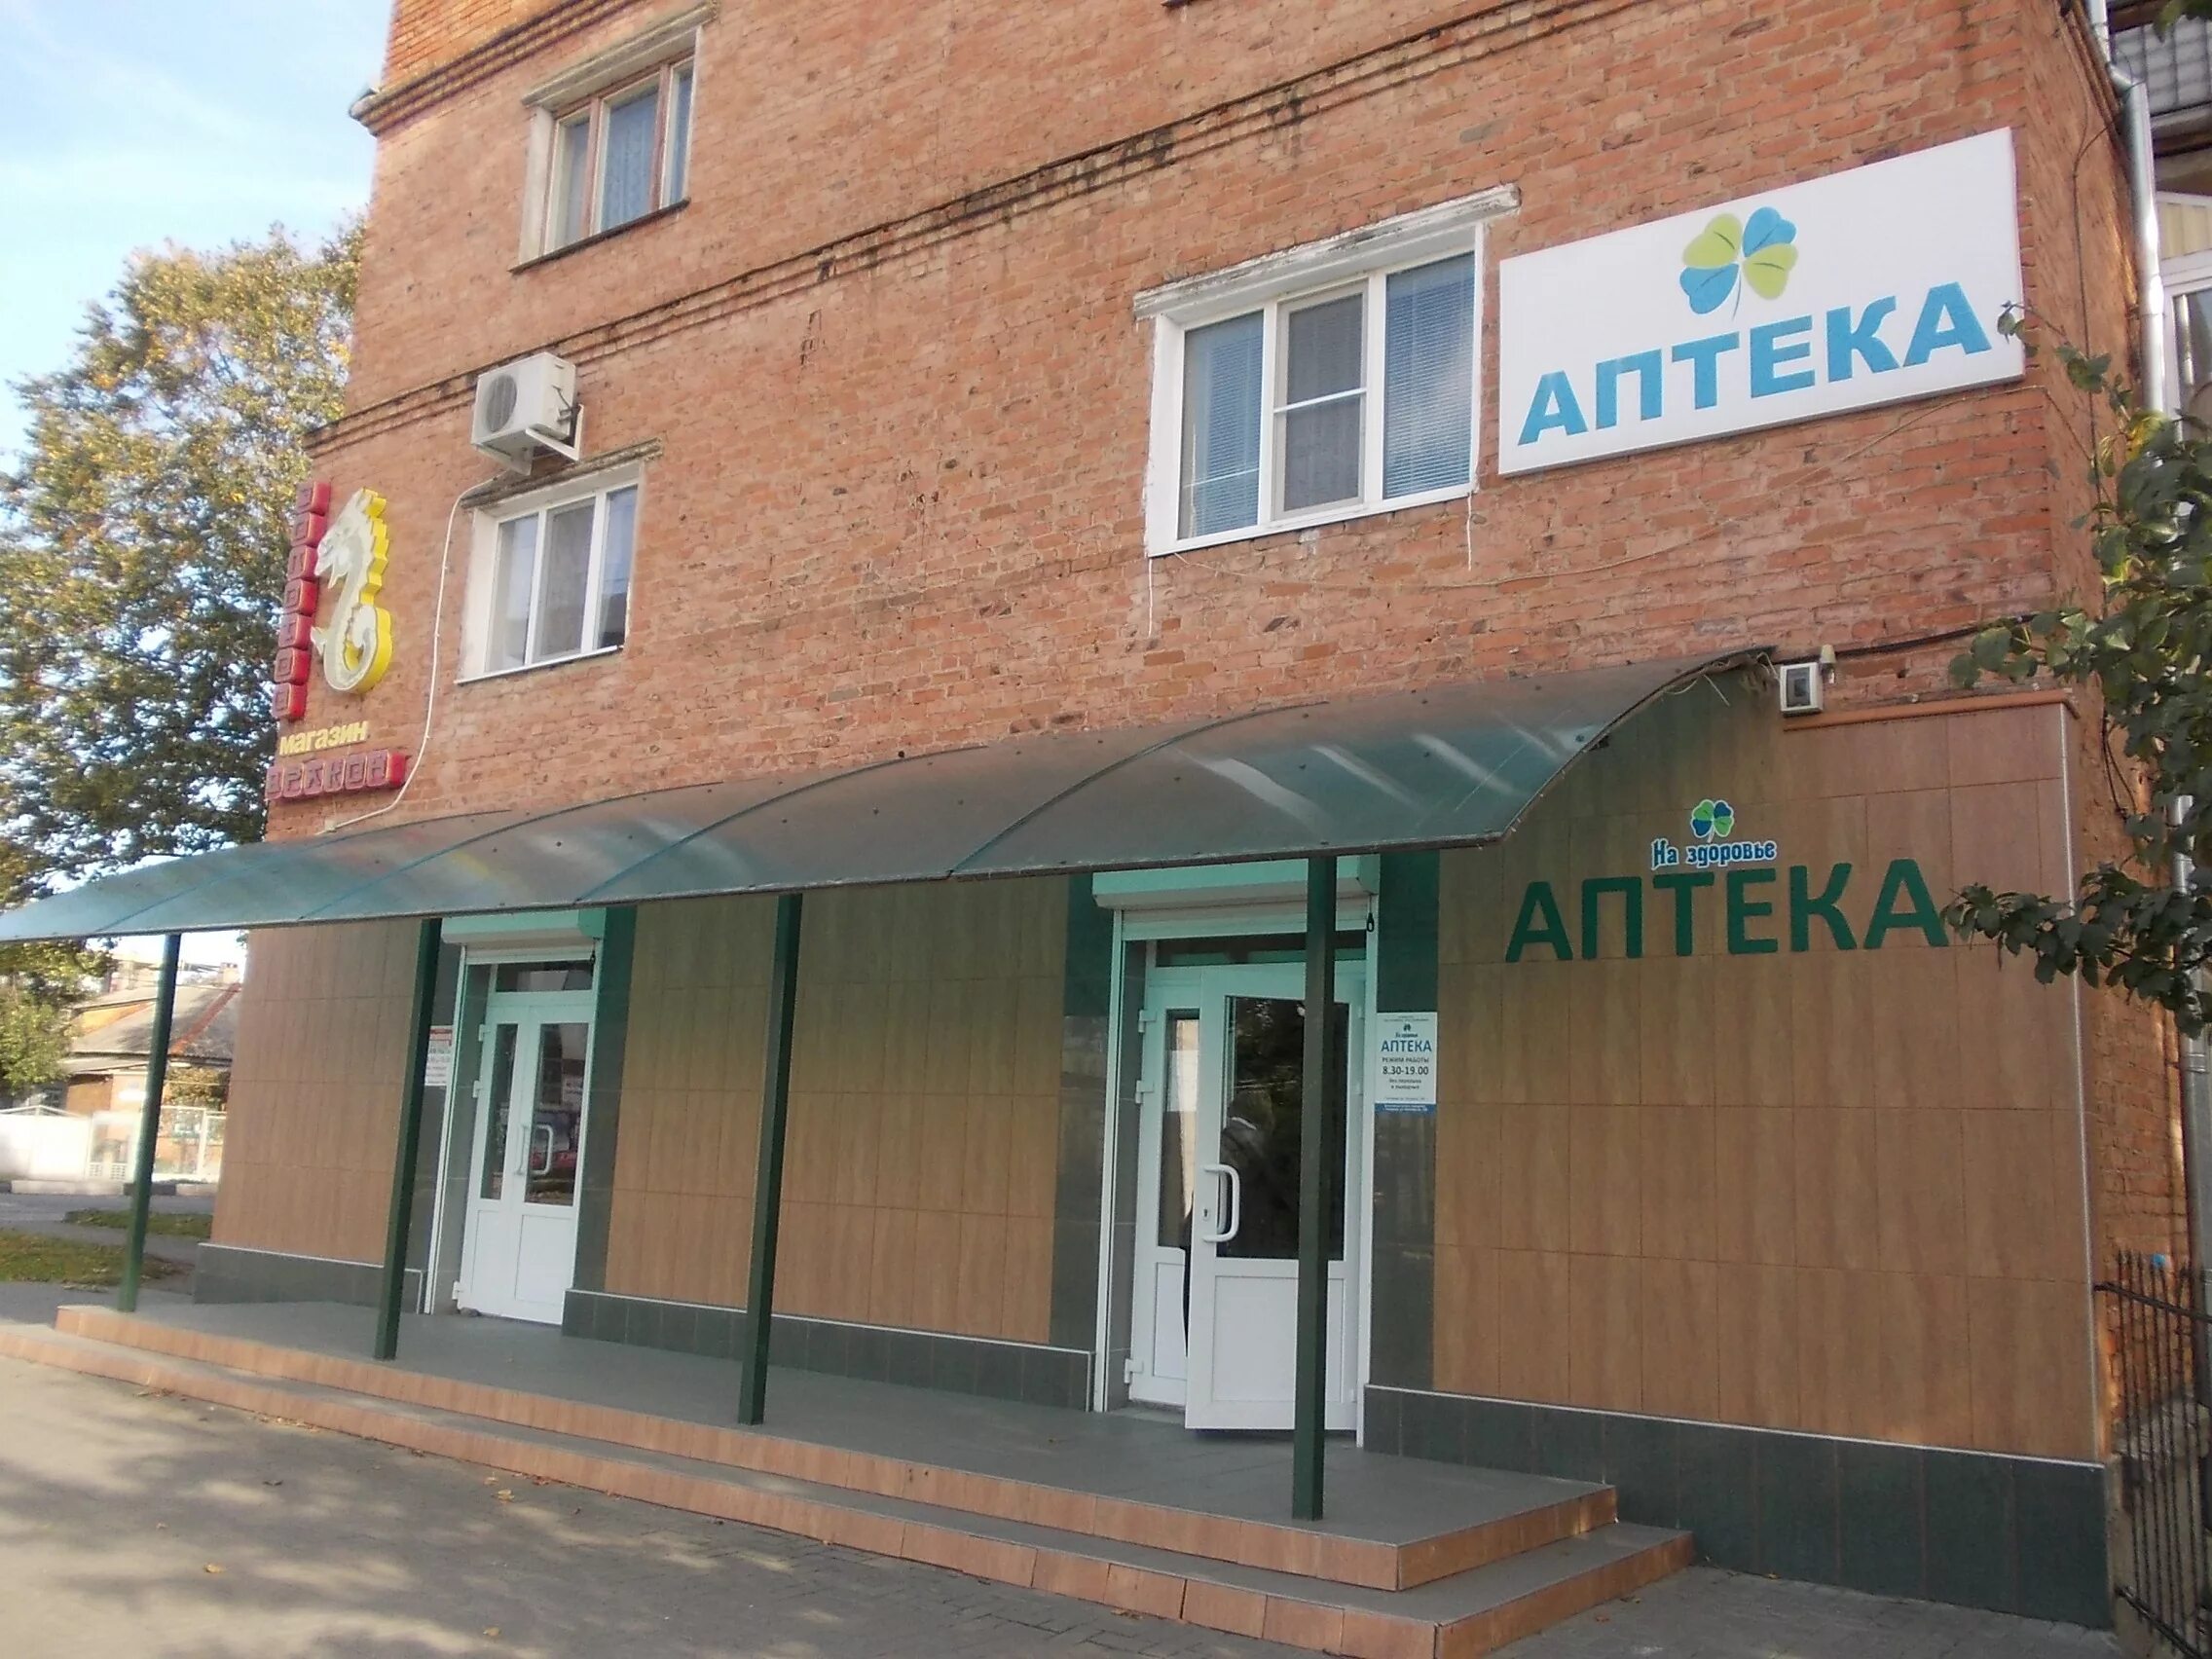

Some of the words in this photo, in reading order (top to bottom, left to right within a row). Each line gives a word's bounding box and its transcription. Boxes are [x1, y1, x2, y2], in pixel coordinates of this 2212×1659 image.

[1517, 280, 1993, 447] АПТЕКА
[278, 719, 370, 756] магазин
[1652, 838, 1679, 869] На
[1686, 840, 1777, 867] здоровье
[1505, 859, 1950, 963] АПТЕКА
[1381, 1040, 1432, 1052] АПТЕКА
[1382, 1066, 1429, 1075] 8.30-19.00
